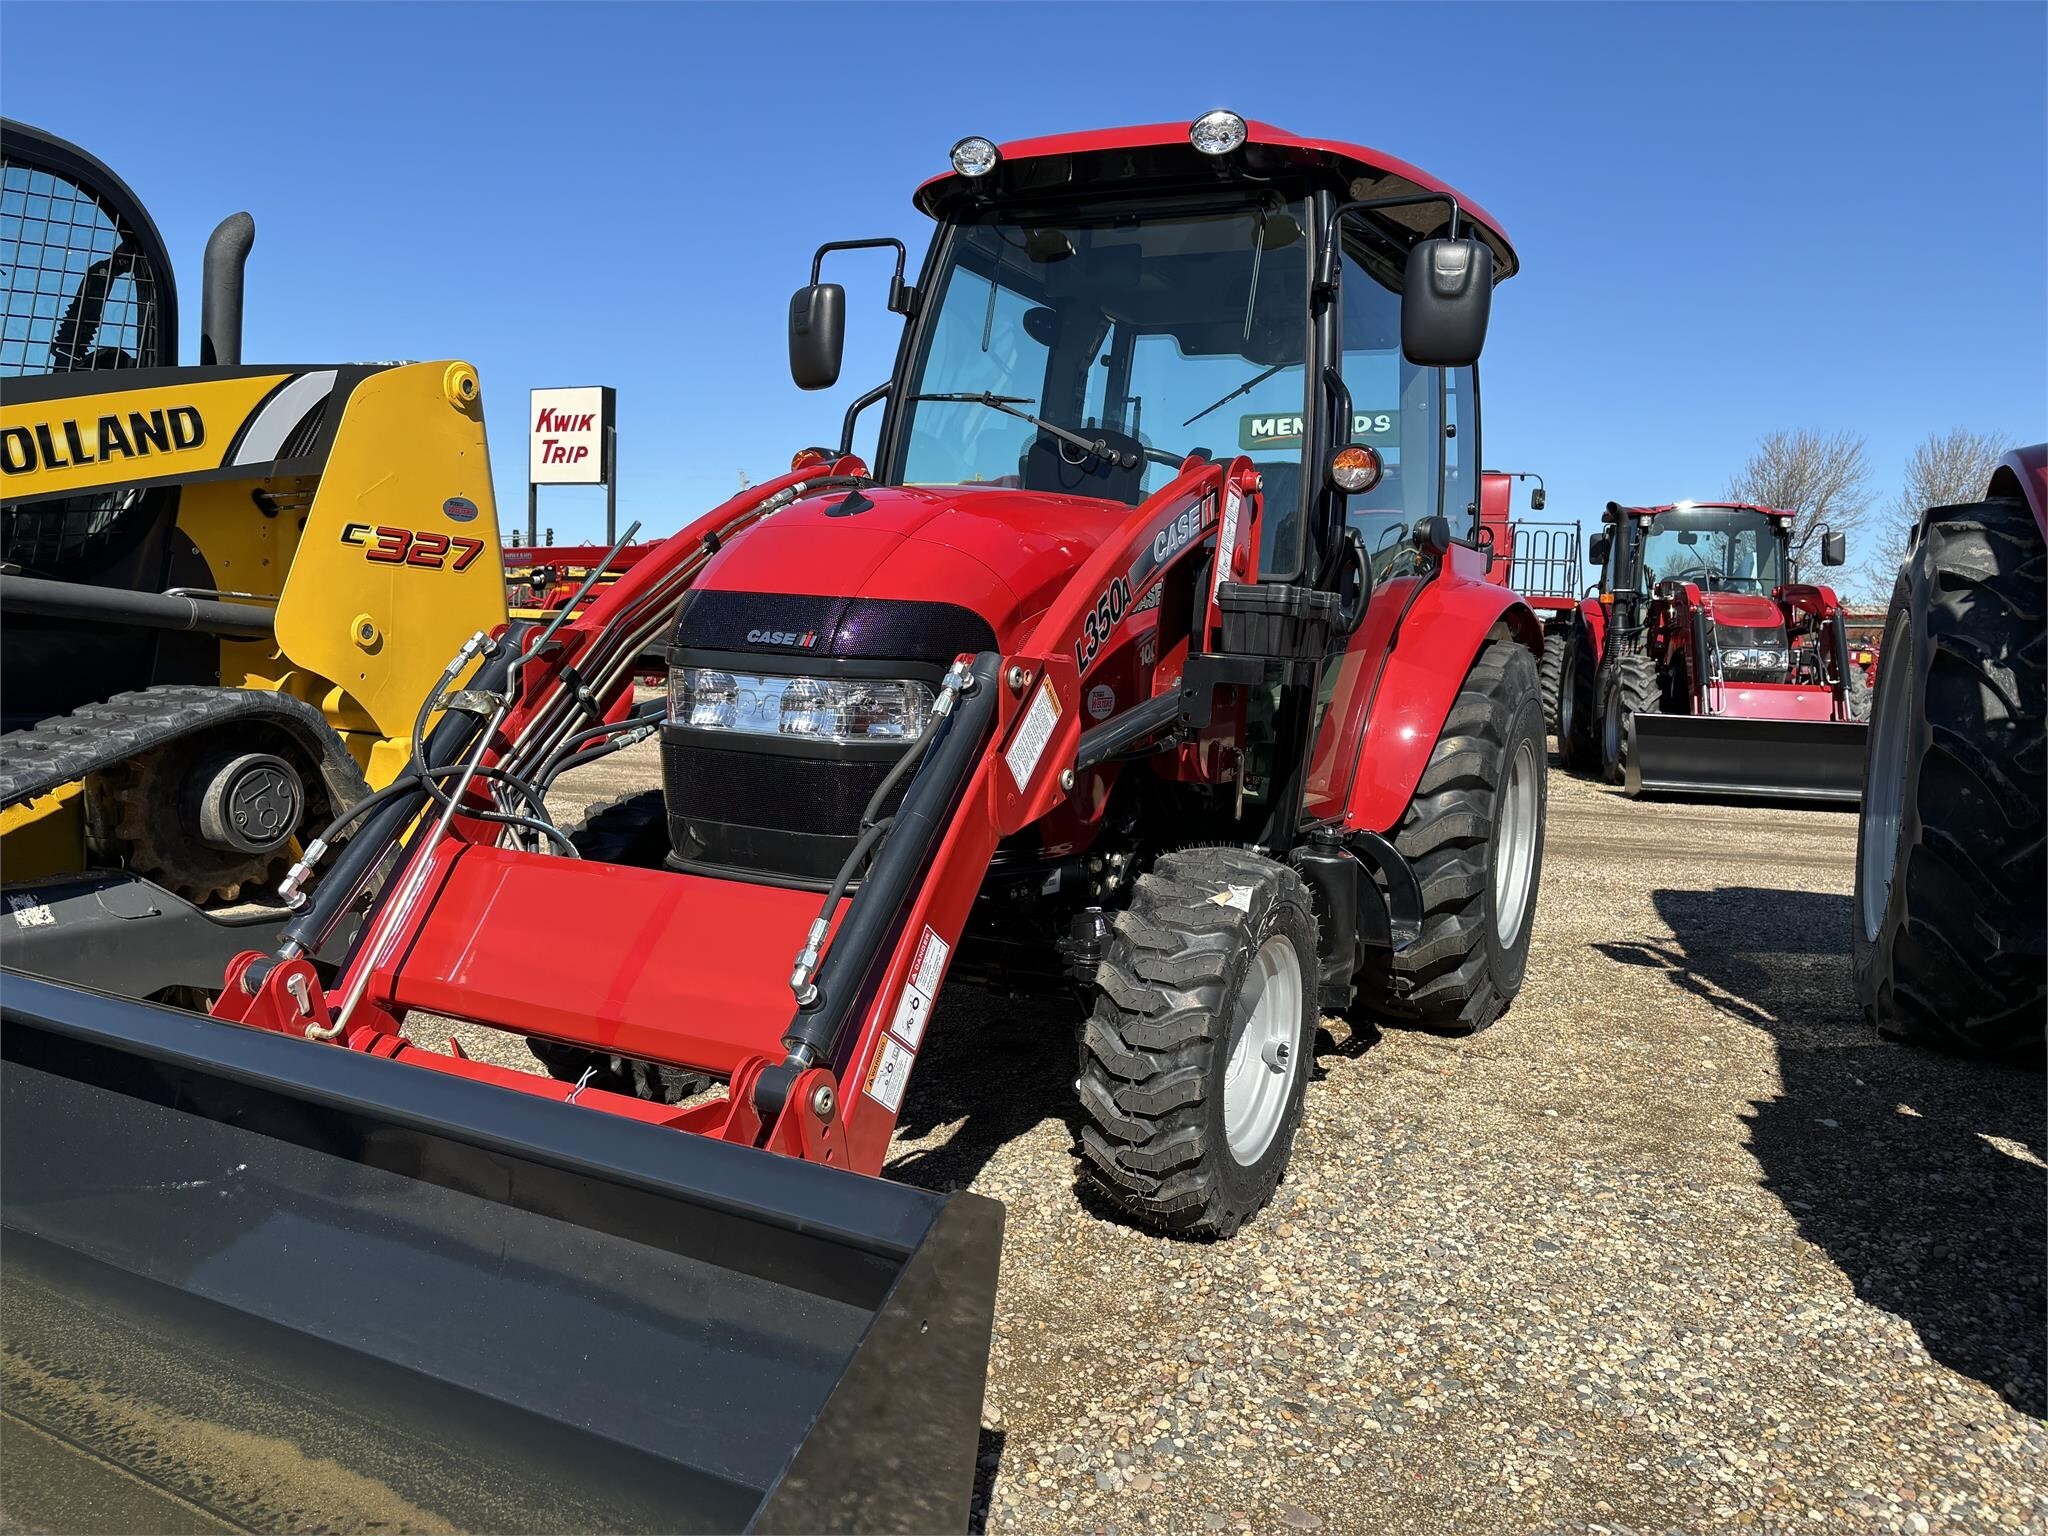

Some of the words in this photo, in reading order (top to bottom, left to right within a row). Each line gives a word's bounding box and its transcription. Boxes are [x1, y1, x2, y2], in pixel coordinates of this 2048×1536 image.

[535, 407, 597, 433] KWIK
[1251, 414, 1391, 437] MENDS
[0, 405, 206, 476] OLLAND
[542, 439, 589, 464] TRIP
[340, 522, 486, 572] C327
[1153, 504, 1200, 563] CASE
[1132, 582, 1162, 613] ASE
[747, 629, 797, 645] CASE
[1075, 574, 1133, 678] L350A
[914, 931, 931, 971] DANGER
